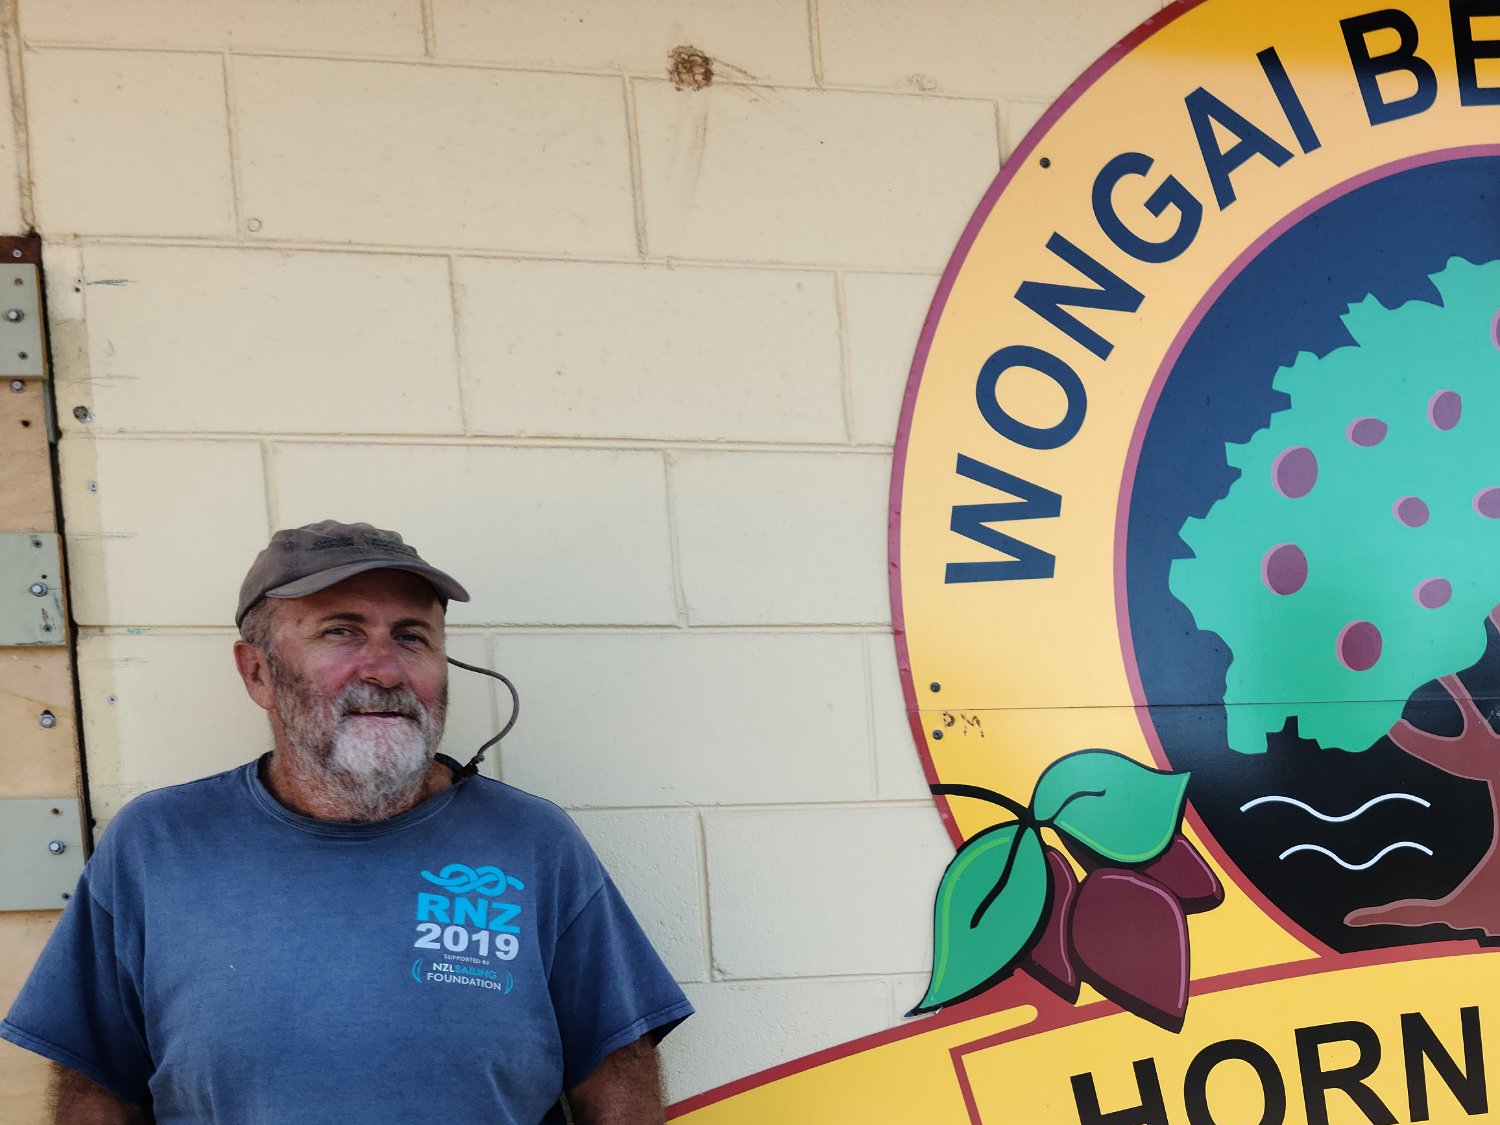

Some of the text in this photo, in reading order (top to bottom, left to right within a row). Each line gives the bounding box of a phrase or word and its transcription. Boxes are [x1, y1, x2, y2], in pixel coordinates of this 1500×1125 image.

[944, 46, 1322, 584] WONGAI
[415, 892, 522, 934] RNZ
[414, 922, 520, 961] 2019
[443, 954, 481, 964] SUPPORTED
[427, 972, 502, 991] FOUNDATION
